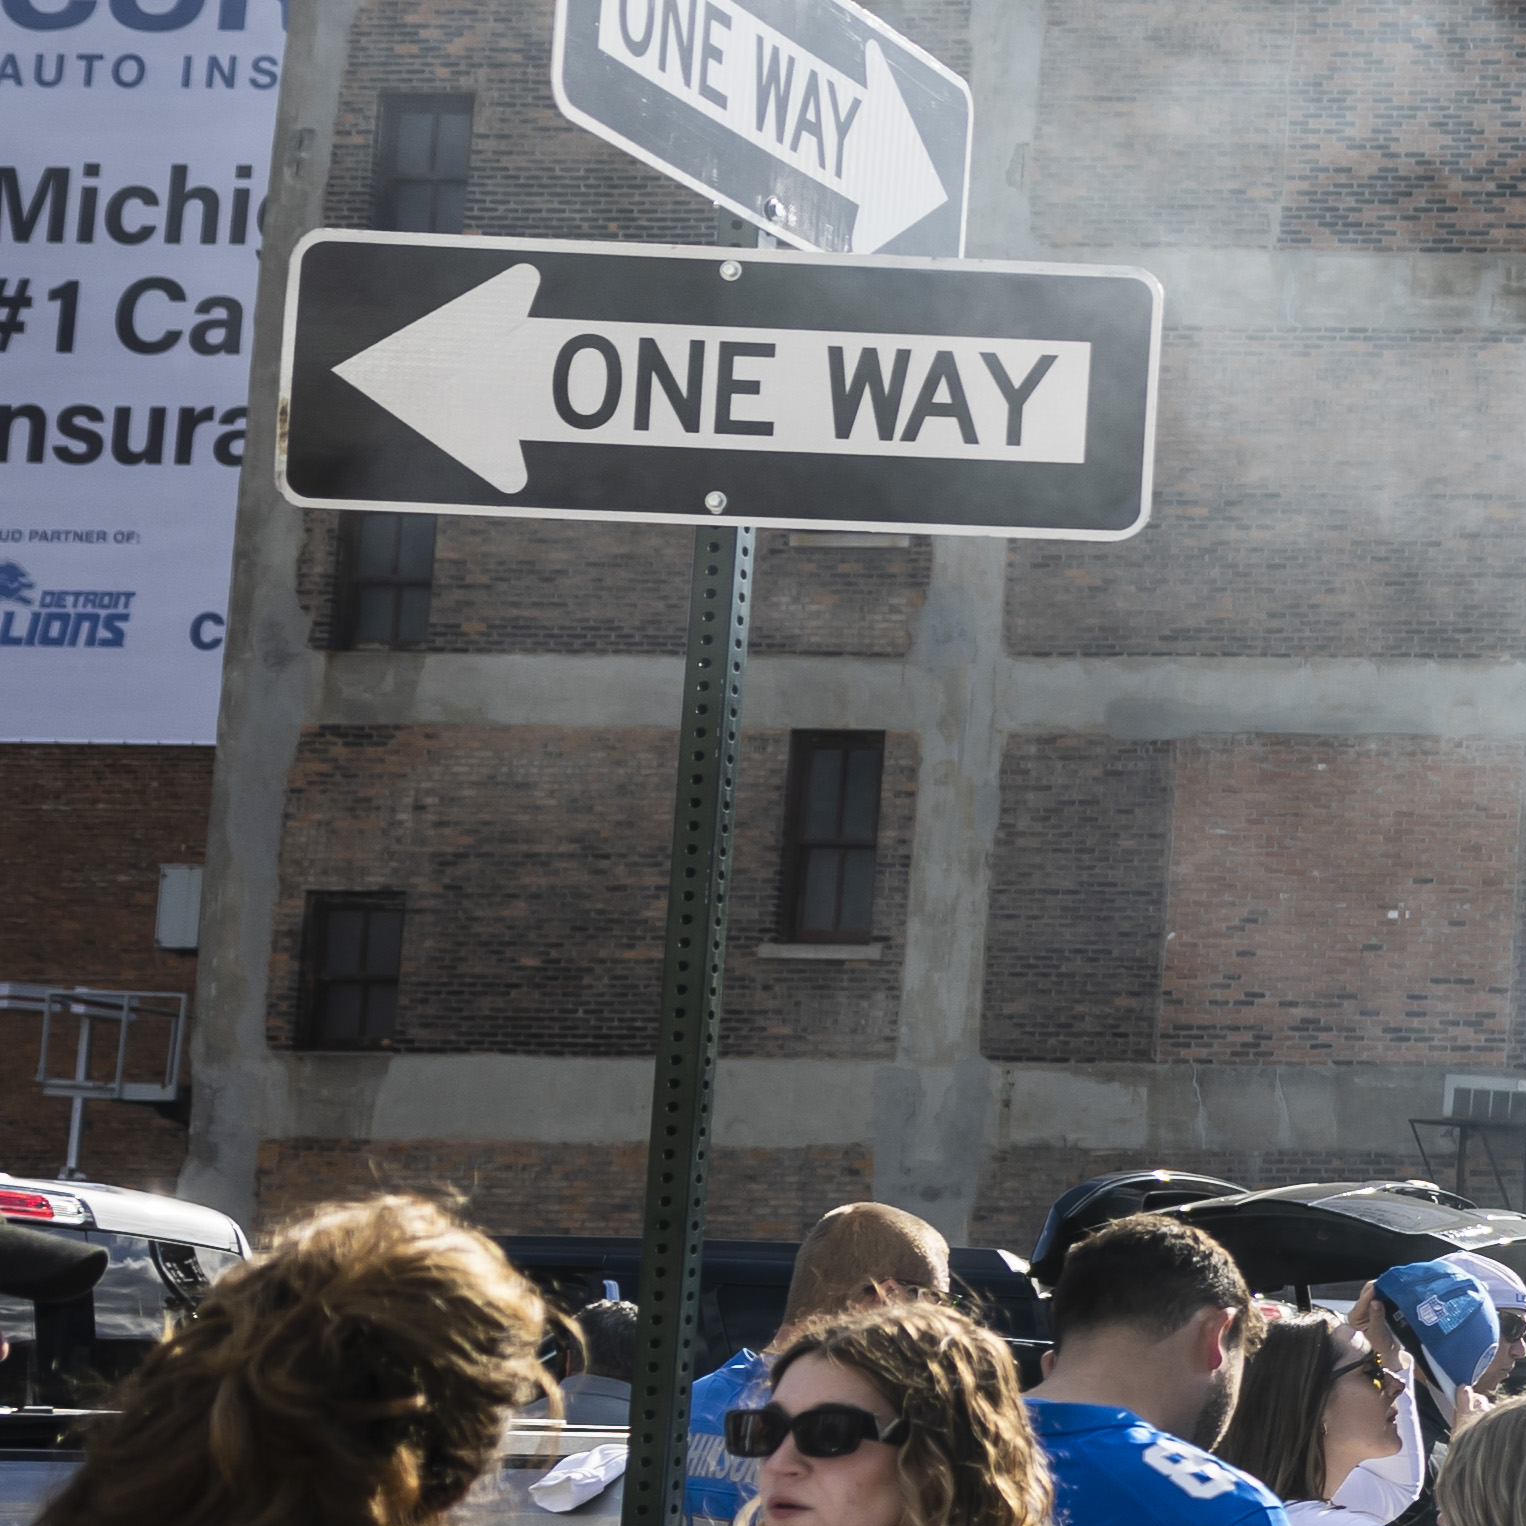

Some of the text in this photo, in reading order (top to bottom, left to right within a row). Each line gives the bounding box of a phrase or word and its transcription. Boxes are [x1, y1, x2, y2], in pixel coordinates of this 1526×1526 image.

[0, 53, 146, 89] AUTO
[619, 0, 862, 180] ONE WAY
[0, 163, 267, 246] Michi
[551, 333, 1058, 446] ONE WAY
[28, 530, 107, 544] PARTNER
[39, 590, 136, 609] DETROIT
[0, 611, 130, 648] LIONS
